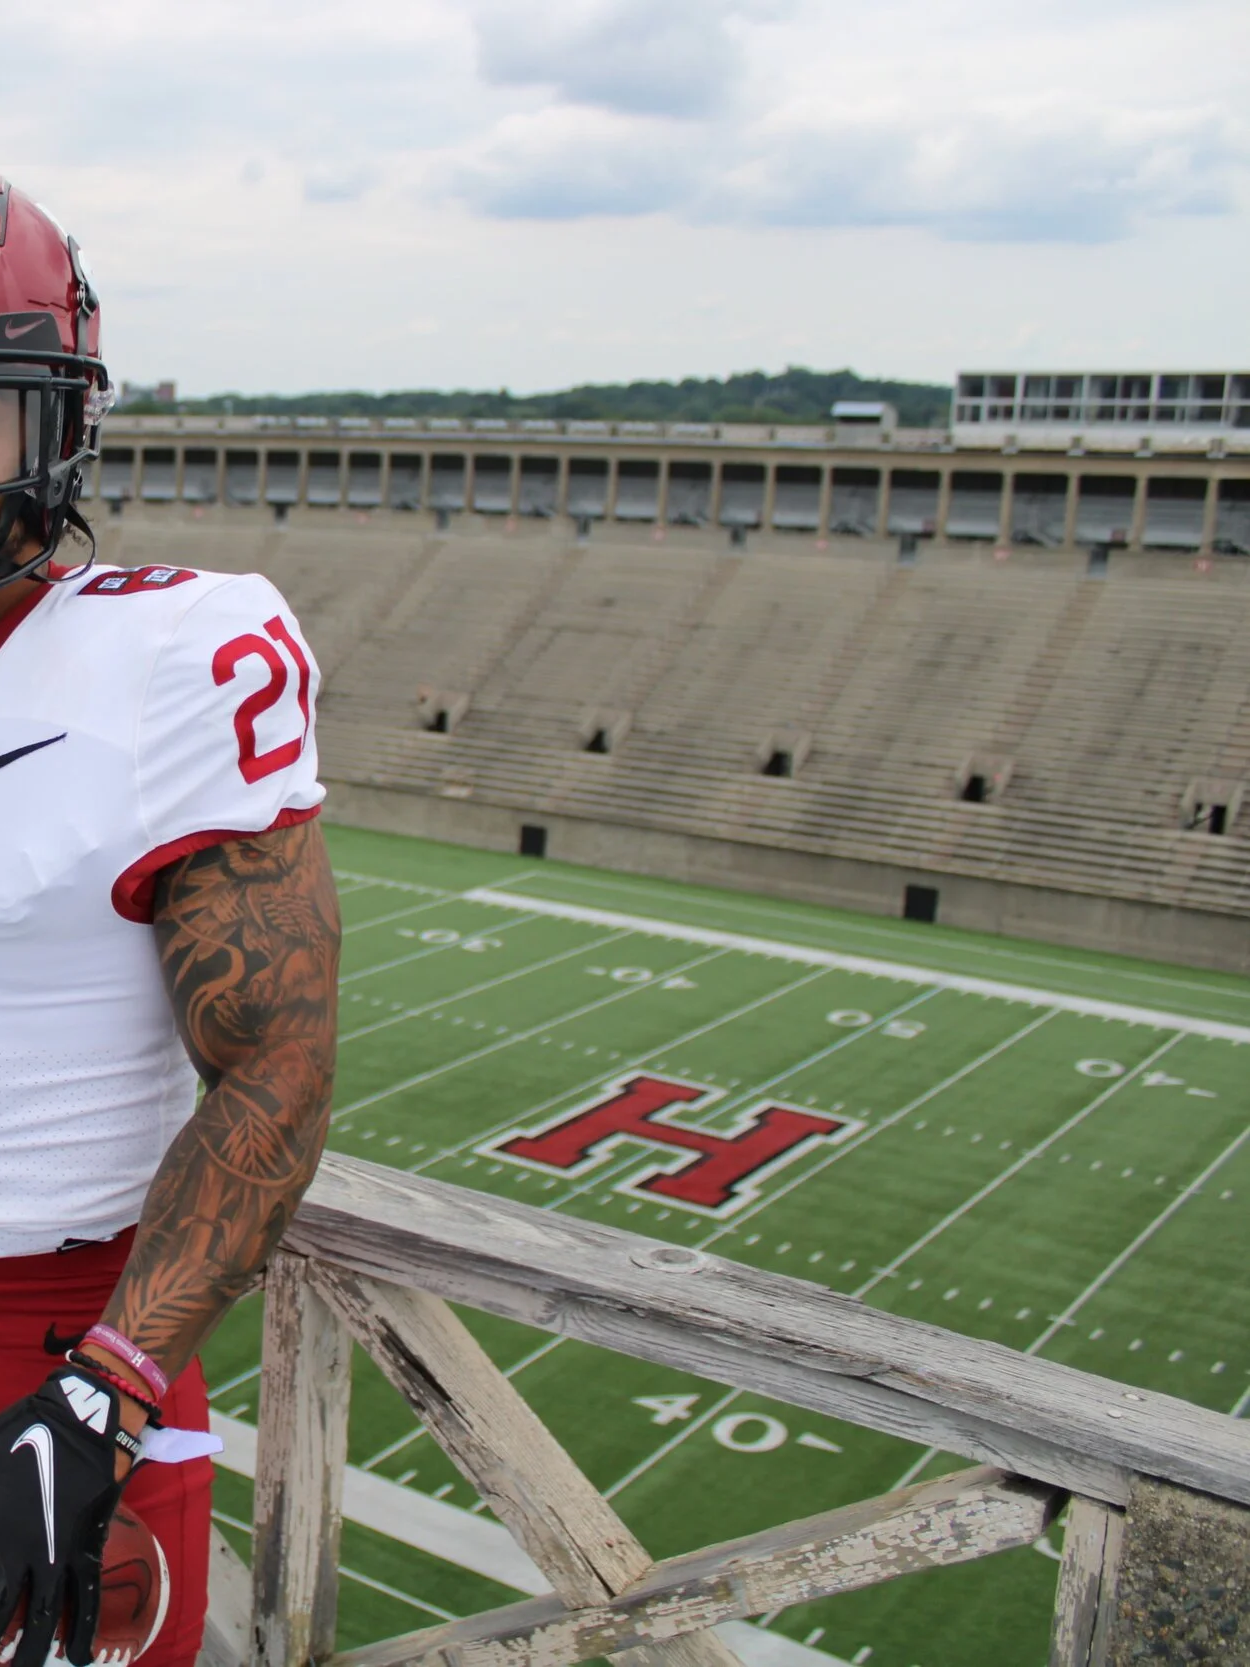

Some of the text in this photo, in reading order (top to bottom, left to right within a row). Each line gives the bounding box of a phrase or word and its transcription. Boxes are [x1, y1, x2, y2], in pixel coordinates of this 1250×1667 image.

[212, 614, 310, 785] 21
[474, 1069, 868, 1219] H
[631, 1393, 788, 1453] 40
